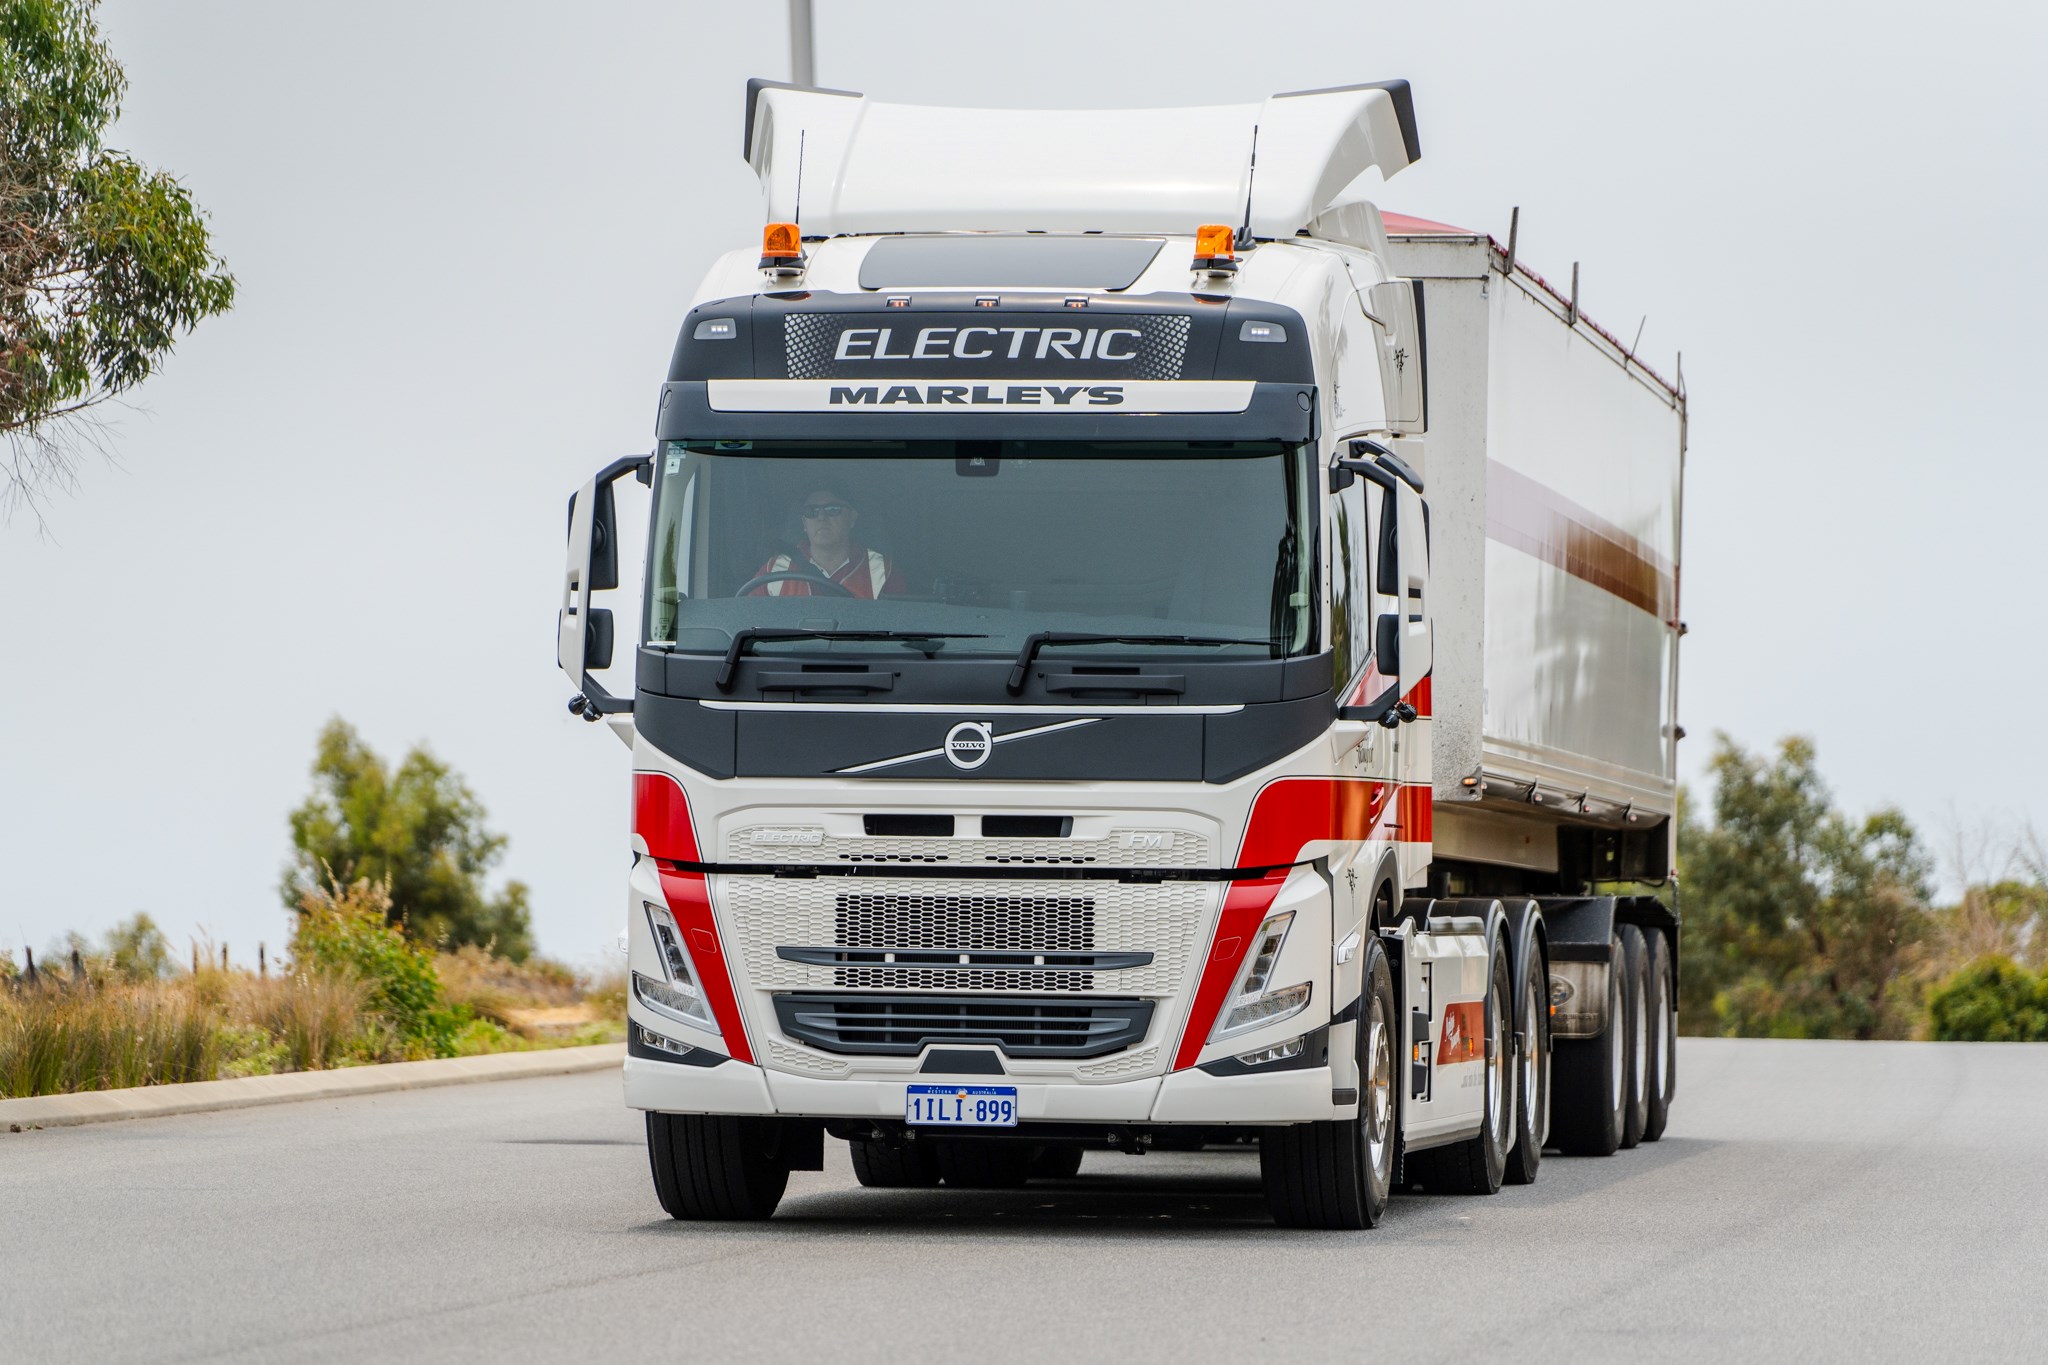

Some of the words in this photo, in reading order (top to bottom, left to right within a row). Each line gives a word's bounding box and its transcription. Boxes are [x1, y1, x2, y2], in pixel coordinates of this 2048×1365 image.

[834, 327, 1142, 360] ELECTRIC
[829, 385, 1124, 405] MARLEY'S
[754, 833, 821, 843] ELECTRIC
[1128, 834, 1163, 849] FM
